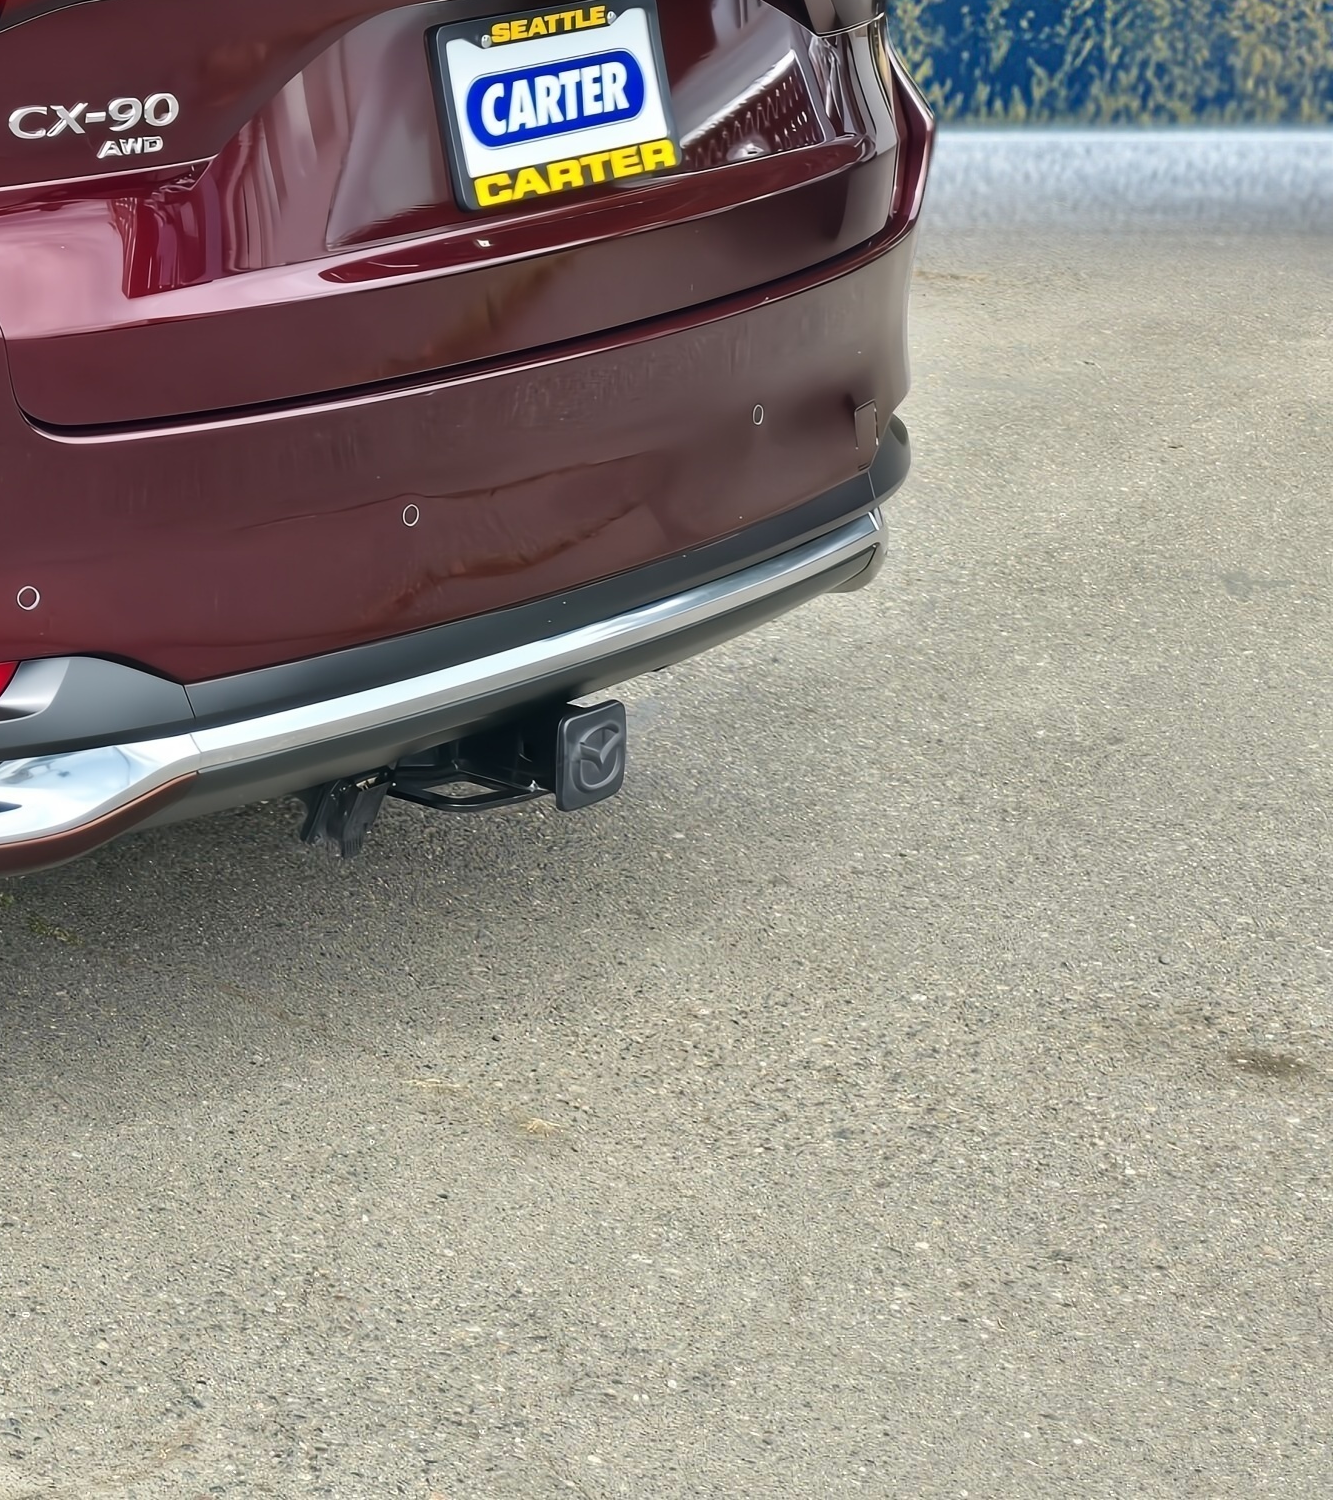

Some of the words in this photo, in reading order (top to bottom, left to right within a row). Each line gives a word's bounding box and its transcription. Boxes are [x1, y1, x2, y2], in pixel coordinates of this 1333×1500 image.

[490, 5, 607, 44] SEATTLE
[7, 92, 181, 140] CX-90
[480, 60, 631, 137] CARTER
[96, 135, 164, 159] AWD
[473, 138, 678, 208] CARTER
